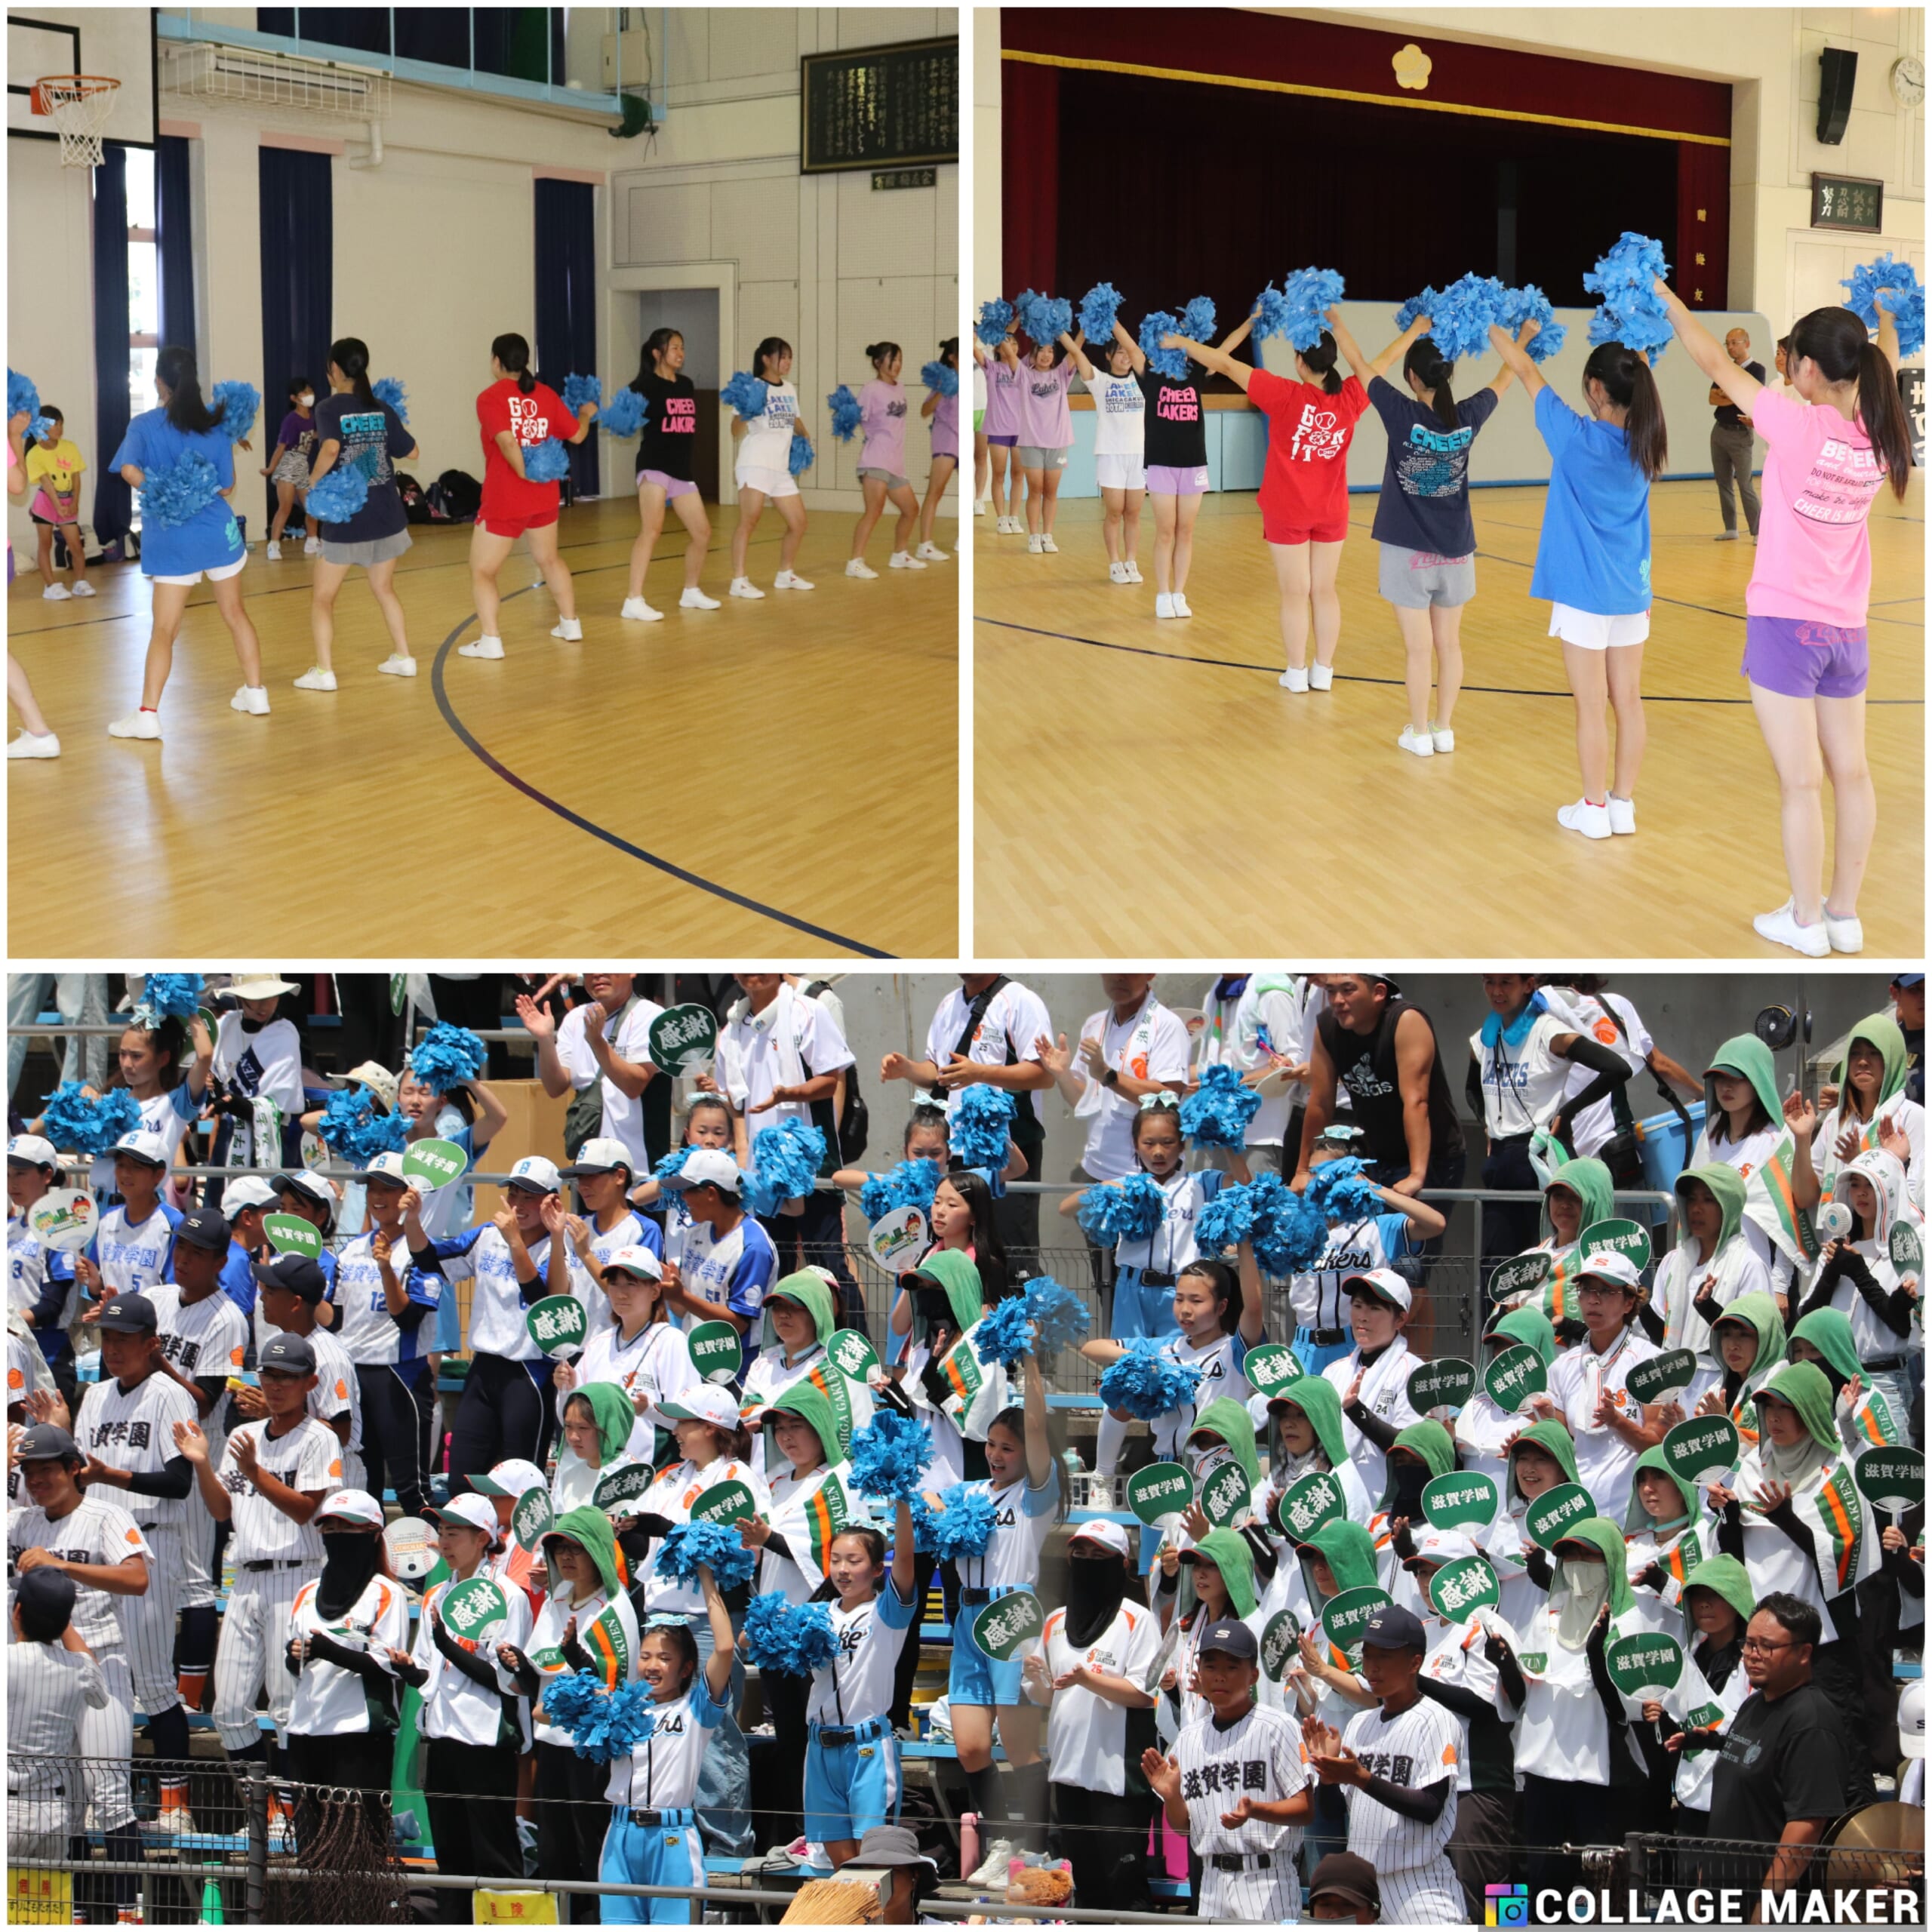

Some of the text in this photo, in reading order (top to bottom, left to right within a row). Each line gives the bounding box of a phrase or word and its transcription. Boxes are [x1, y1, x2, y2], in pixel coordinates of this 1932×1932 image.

[1159, 386, 1197, 403] CHEER
[340, 411, 386, 435] CHEER
[1157, 401, 1198, 421] LAKERS
[1810, 467, 1823, 478] DO
[1823, 471, 1836, 481] NOT
[1835, 475, 1844, 484] BE
[1802, 489, 1831, 502] make
[1793, 497, 1832, 521] CHEER
[1832, 509, 1842, 522] IS
[657, 1011, 711, 1051] 感謝
[1345, 1078, 1394, 1097] adidas
[411, 1148, 459, 1174] 滋賀学園
[188, 1218, 202, 1229] S
[270, 1225, 316, 1247] 滋賀学園
[1587, 1232, 1643, 1254] 滋賀学園
[1893, 1231, 1921, 1263] 感謝
[12, 1260, 23, 1279] 3
[1295, 1248, 1373, 1274] akers
[1593, 1258, 1609, 1267] S
[1495, 1257, 1549, 1293] 感謝
[107, 1305, 122, 1315] S
[371, 1291, 388, 1312] 12
[534, 1303, 583, 1341] 感謝
[271, 1345, 285, 1355] S
[693, 1335, 737, 1357] 滋賀学園
[835, 1332, 871, 1374] 感謝
[1251, 1349, 1300, 1386] 感謝
[1491, 1355, 1539, 1395] 滋賀学園
[1634, 1355, 1690, 1388] 滋賀学園
[1414, 1371, 1469, 1395] 滋賀学園
[1376, 1404, 1388, 1415] 24
[1626, 1408, 1638, 1419] 24
[23, 1439, 36, 1451] S
[840, 1413, 852, 1455] SHIGA
[1672, 1427, 1732, 1460] 滋賀学園
[1864, 1463, 1925, 1480] 滋賀学園
[598, 1468, 651, 1503] 感謝
[1134, 1476, 1188, 1504] 滋賀学園
[1207, 1466, 1247, 1521] 感謝
[1430, 1485, 1491, 1510] 滋賀学園
[515, 1491, 551, 1543] 感謝
[697, 1491, 749, 1523] 滋賀学園
[1287, 1476, 1337, 1534] 感謝
[1533, 1494, 1587, 1535] 滋賀学園
[1438, 1561, 1494, 1613] 感謝
[450, 1581, 501, 1631] 感謝
[1330, 1599, 1387, 1630] 滋賀学園
[981, 1595, 1038, 1651] 感謝
[1214, 1629, 1232, 1639] S
[1369, 1619, 1384, 1630] S
[1263, 1614, 1300, 1671] 感謝
[1091, 1663, 1103, 1674] 26
[1615, 1647, 1675, 1672] 滋賀学園
[1183, 1759, 1267, 1801] 滋賀学園
